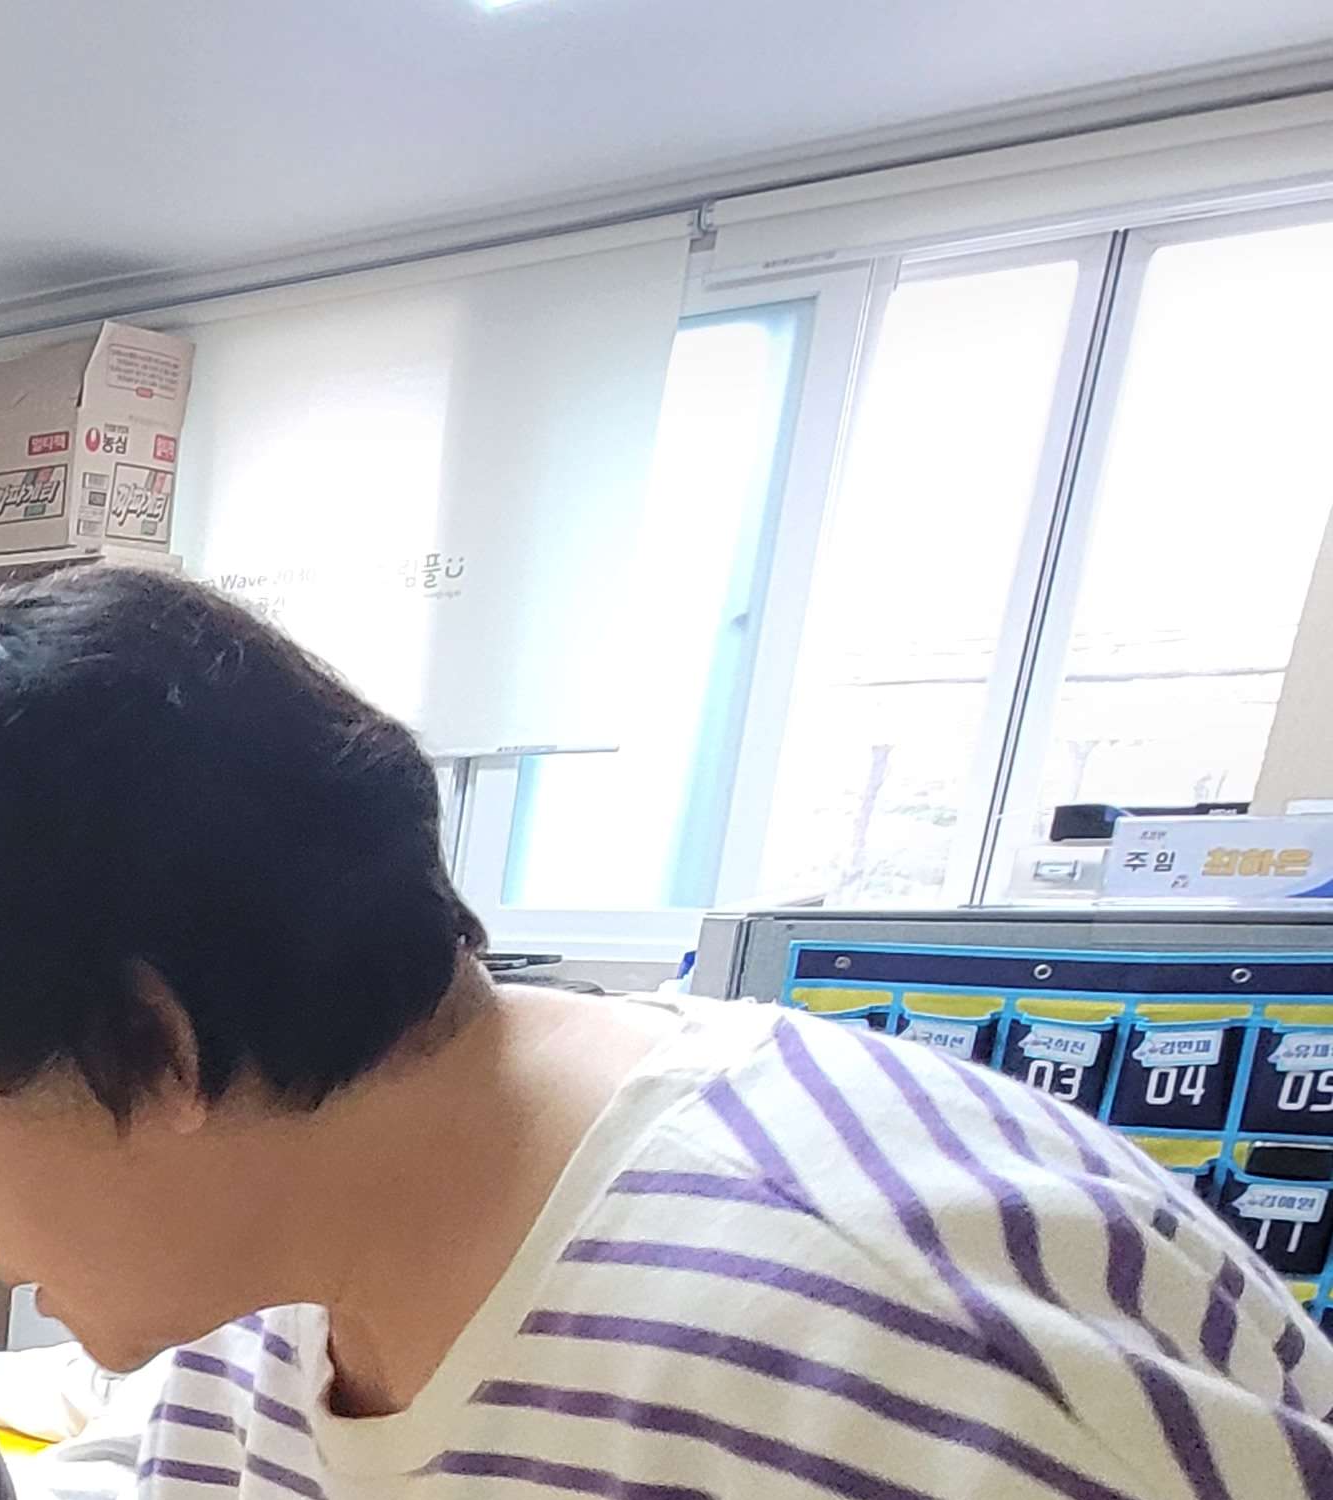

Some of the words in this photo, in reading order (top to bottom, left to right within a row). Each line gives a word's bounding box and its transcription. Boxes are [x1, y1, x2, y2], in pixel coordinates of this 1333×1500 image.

[102, 434, 128, 455] 농심
[220, 573, 268, 591] Wave
[1124, 850, 1176, 873] 주임
[1294, 1042, 1333, 1059] 유재
[1026, 1059, 1083, 1102] 03
[1145, 1064, 1207, 1106] 04
[1255, 1218, 1303, 1253] 11
